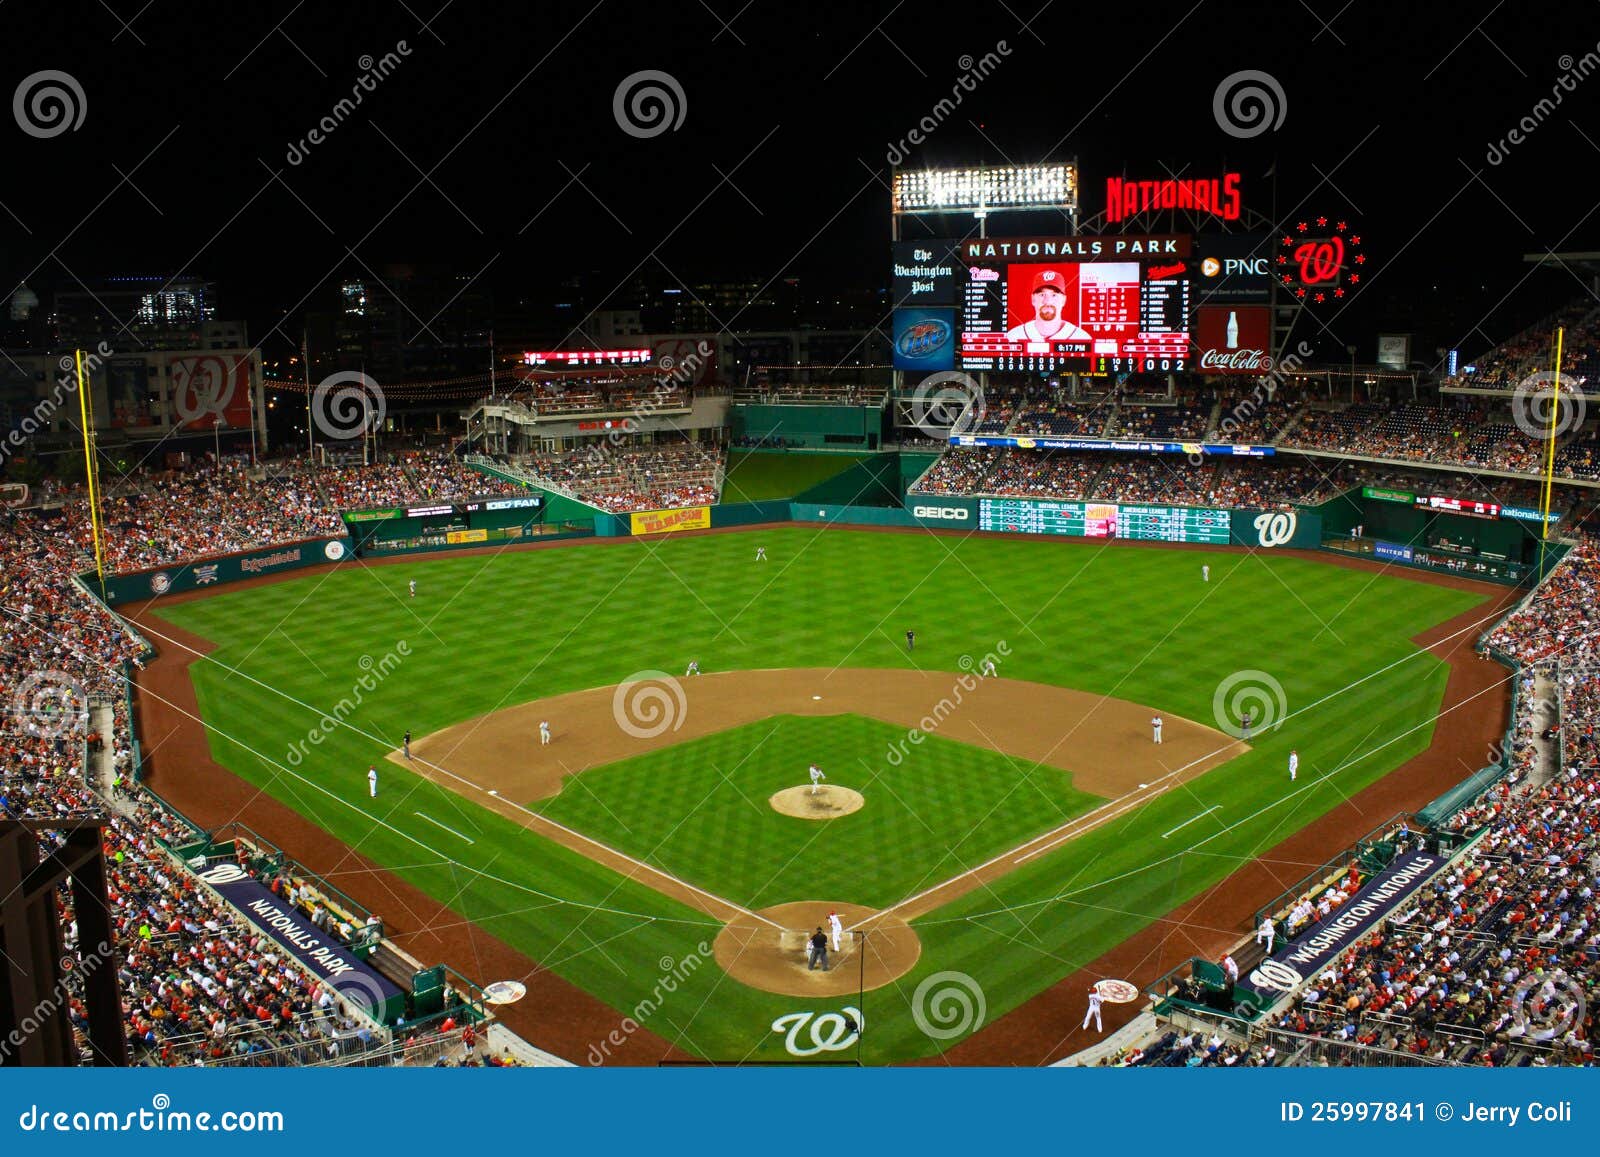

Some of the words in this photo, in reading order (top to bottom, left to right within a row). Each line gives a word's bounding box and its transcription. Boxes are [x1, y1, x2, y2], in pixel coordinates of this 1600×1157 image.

[1106, 173, 1241, 222] NATIONALS
[913, 249, 933, 261] The
[969, 241, 1102, 256] NATIONALS
[1116, 240, 1177, 253] PARK
[1224, 258, 1269, 275] PNC
[1294, 236, 1344, 284] W
[894, 263, 952, 278] Washington
[911, 280, 935, 295] Post
[1147, 360, 1155, 370] 0
[1161, 360, 1169, 370] 0
[1176, 360, 1184, 370] 2
[1201, 349, 1264, 369] Coca-Cola
[514, 498, 540, 508] FAN
[913, 506, 968, 520] GEICO
[1254, 512, 1297, 547] W
[1289, 899, 1380, 964] WASHINGTON
[1367, 856, 1434, 903] NATIONALS
[248, 898, 319, 950] NATIONALS
[308, 946, 355, 976] PARK
[771, 1006, 865, 1057] W
